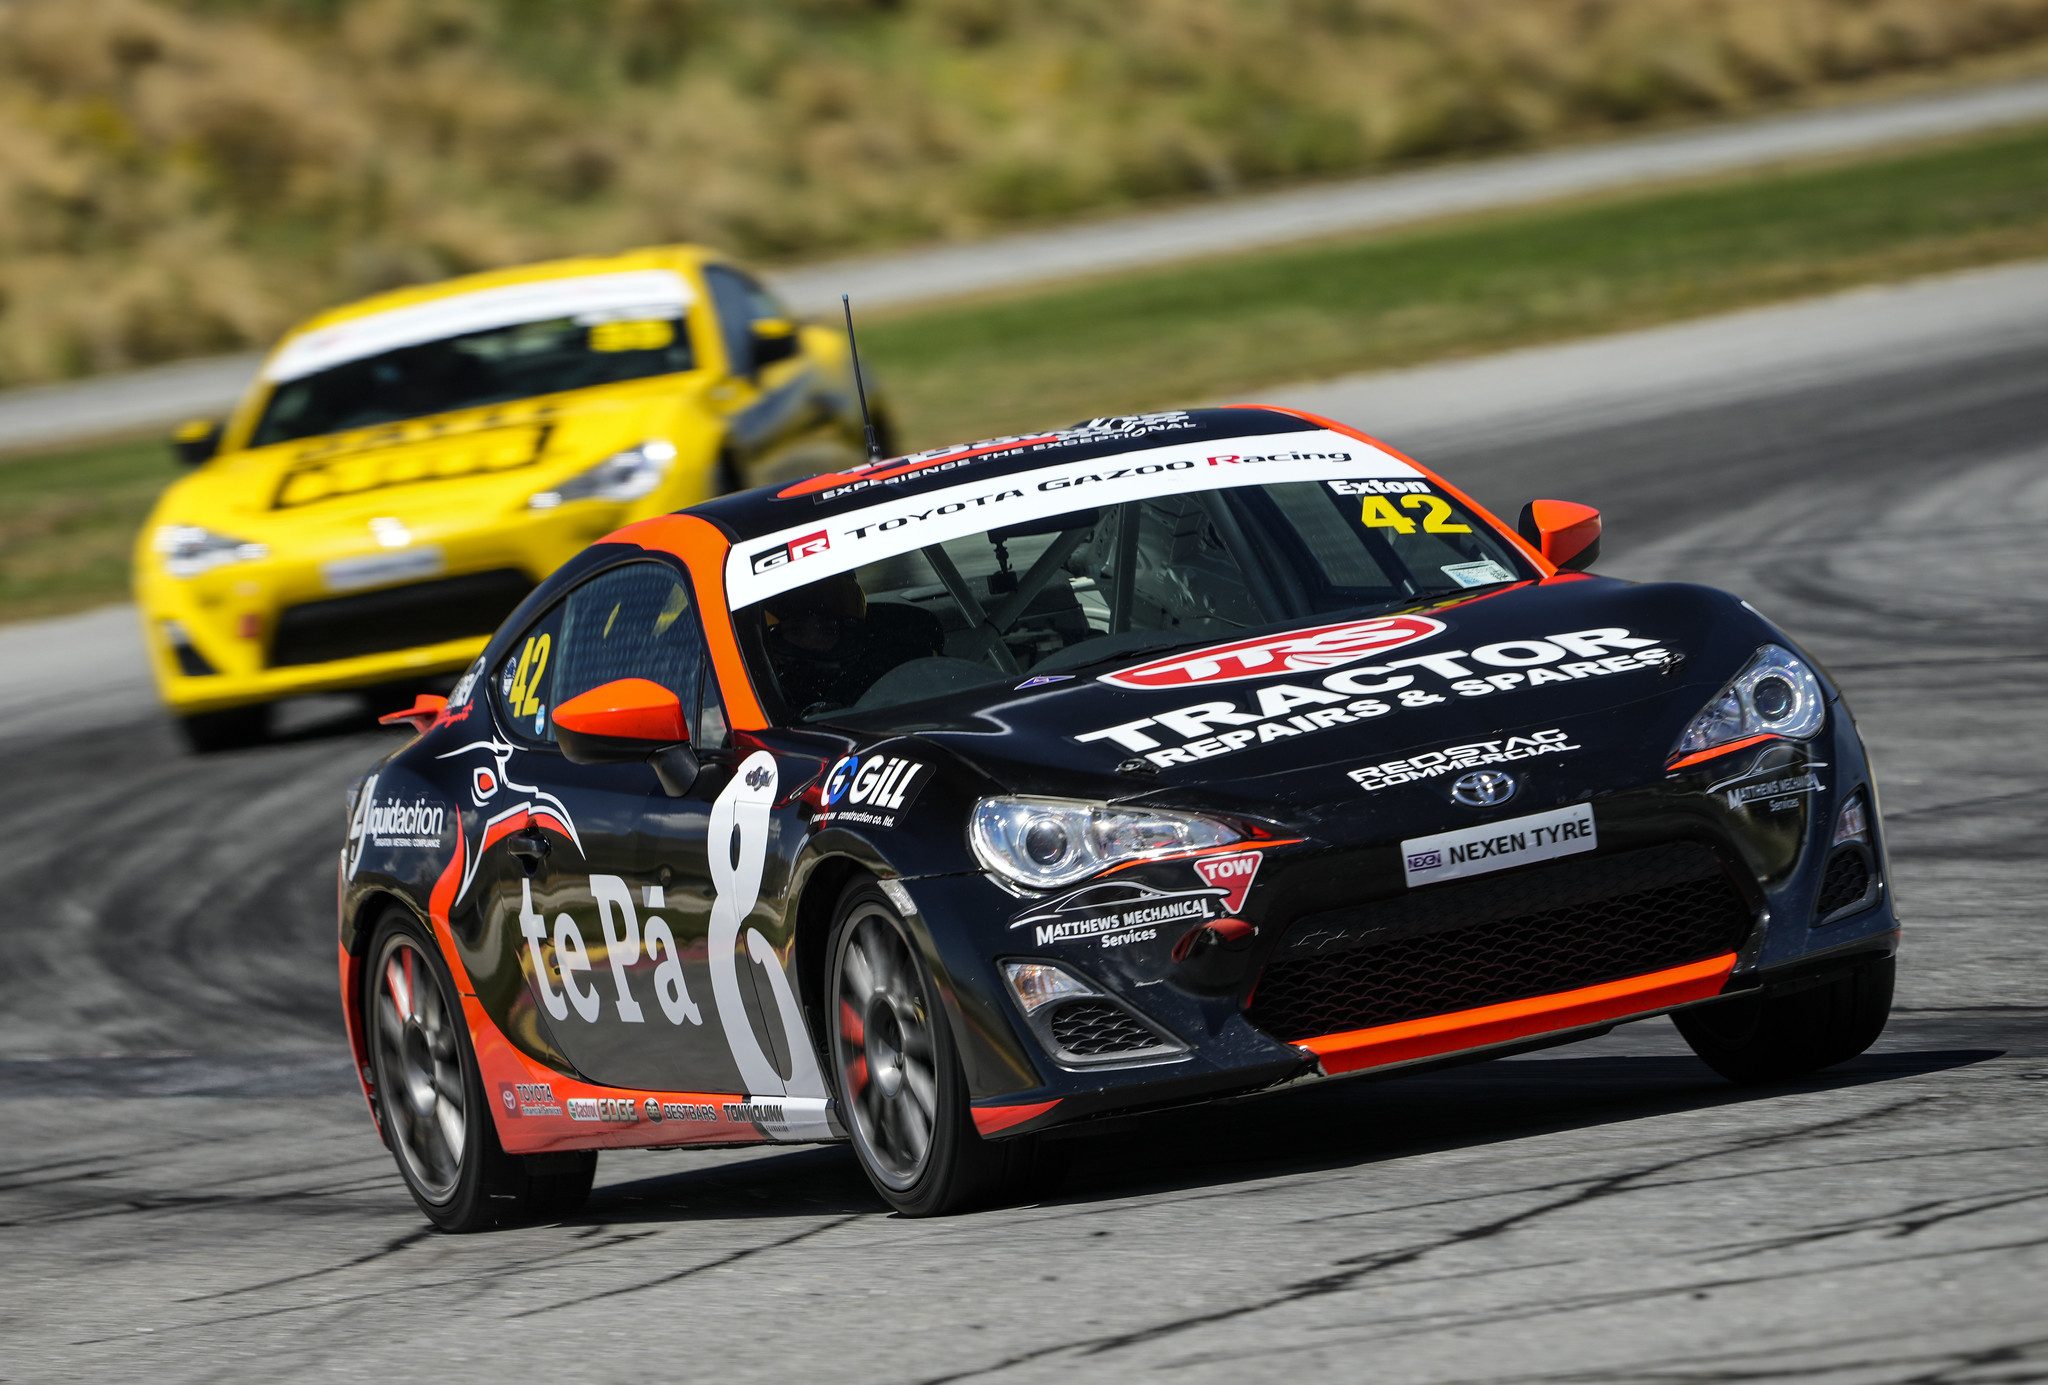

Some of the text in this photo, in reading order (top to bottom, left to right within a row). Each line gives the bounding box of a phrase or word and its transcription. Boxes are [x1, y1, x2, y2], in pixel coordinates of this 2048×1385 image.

[978, 447, 1025, 461] THE
[1032, 421, 1197, 452] EXCEPTIONAL
[1327, 479, 1433, 496] Exton
[752, 451, 1352, 575] GR TOYOTA GAZOO Racing
[1361, 493, 1474, 535] 42
[1132, 619, 1417, 681] TRS
[508, 632, 551, 719] 42
[1073, 627, 1662, 753] TRACTOR
[1143, 648, 1672, 769] REPAIRS & SPARES
[1346, 728, 1569, 783] REDSTAG
[1360, 743, 1582, 791] COMMERCIAL
[1407, 818, 1593, 869] NEXEN NEXEN TYRE
[1203, 858, 1255, 880] TOW
[1035, 898, 1215, 947] MATTHEWS MECHANICAL
[1101, 928, 1157, 949] Services
[518, 877, 601, 1024] te
[515, 1084, 555, 1102] TOYOTA
[599, 1098, 639, 1122] EDGE
[663, 1103, 718, 1122] BESTBARS
